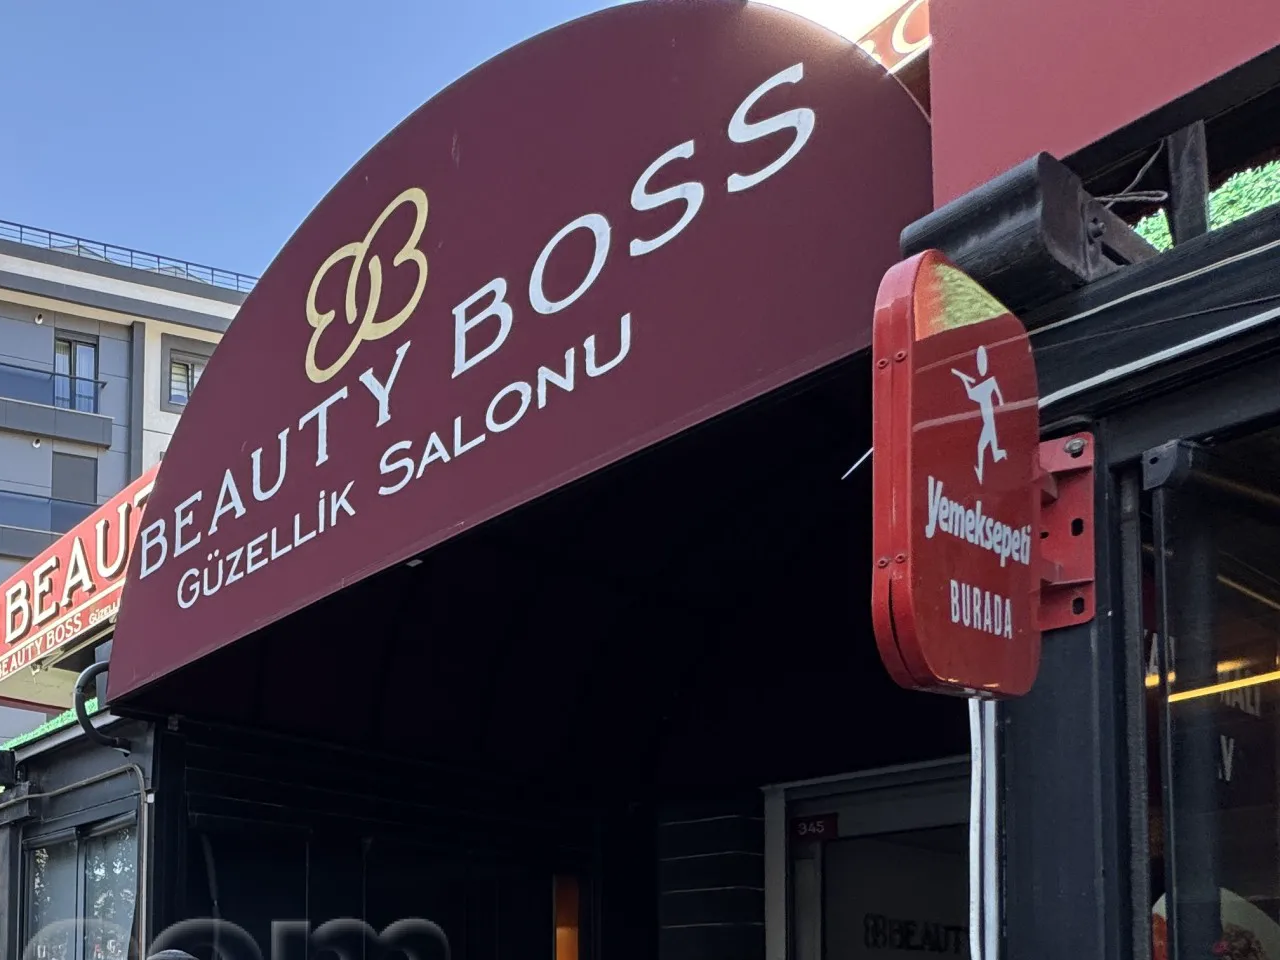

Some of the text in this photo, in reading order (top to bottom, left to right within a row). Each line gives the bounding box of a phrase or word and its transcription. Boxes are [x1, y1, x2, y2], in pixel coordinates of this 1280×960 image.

[139, 62, 816, 581] BEAUTY BOSS
[176, 312, 633, 610] GÜZELLİK SALONU
[925, 475, 1032, 567] Yemeksepeti
[46, 613, 82, 648] BOSS
[950, 579, 1013, 639] BURADA
[798, 820, 825, 836] 345
